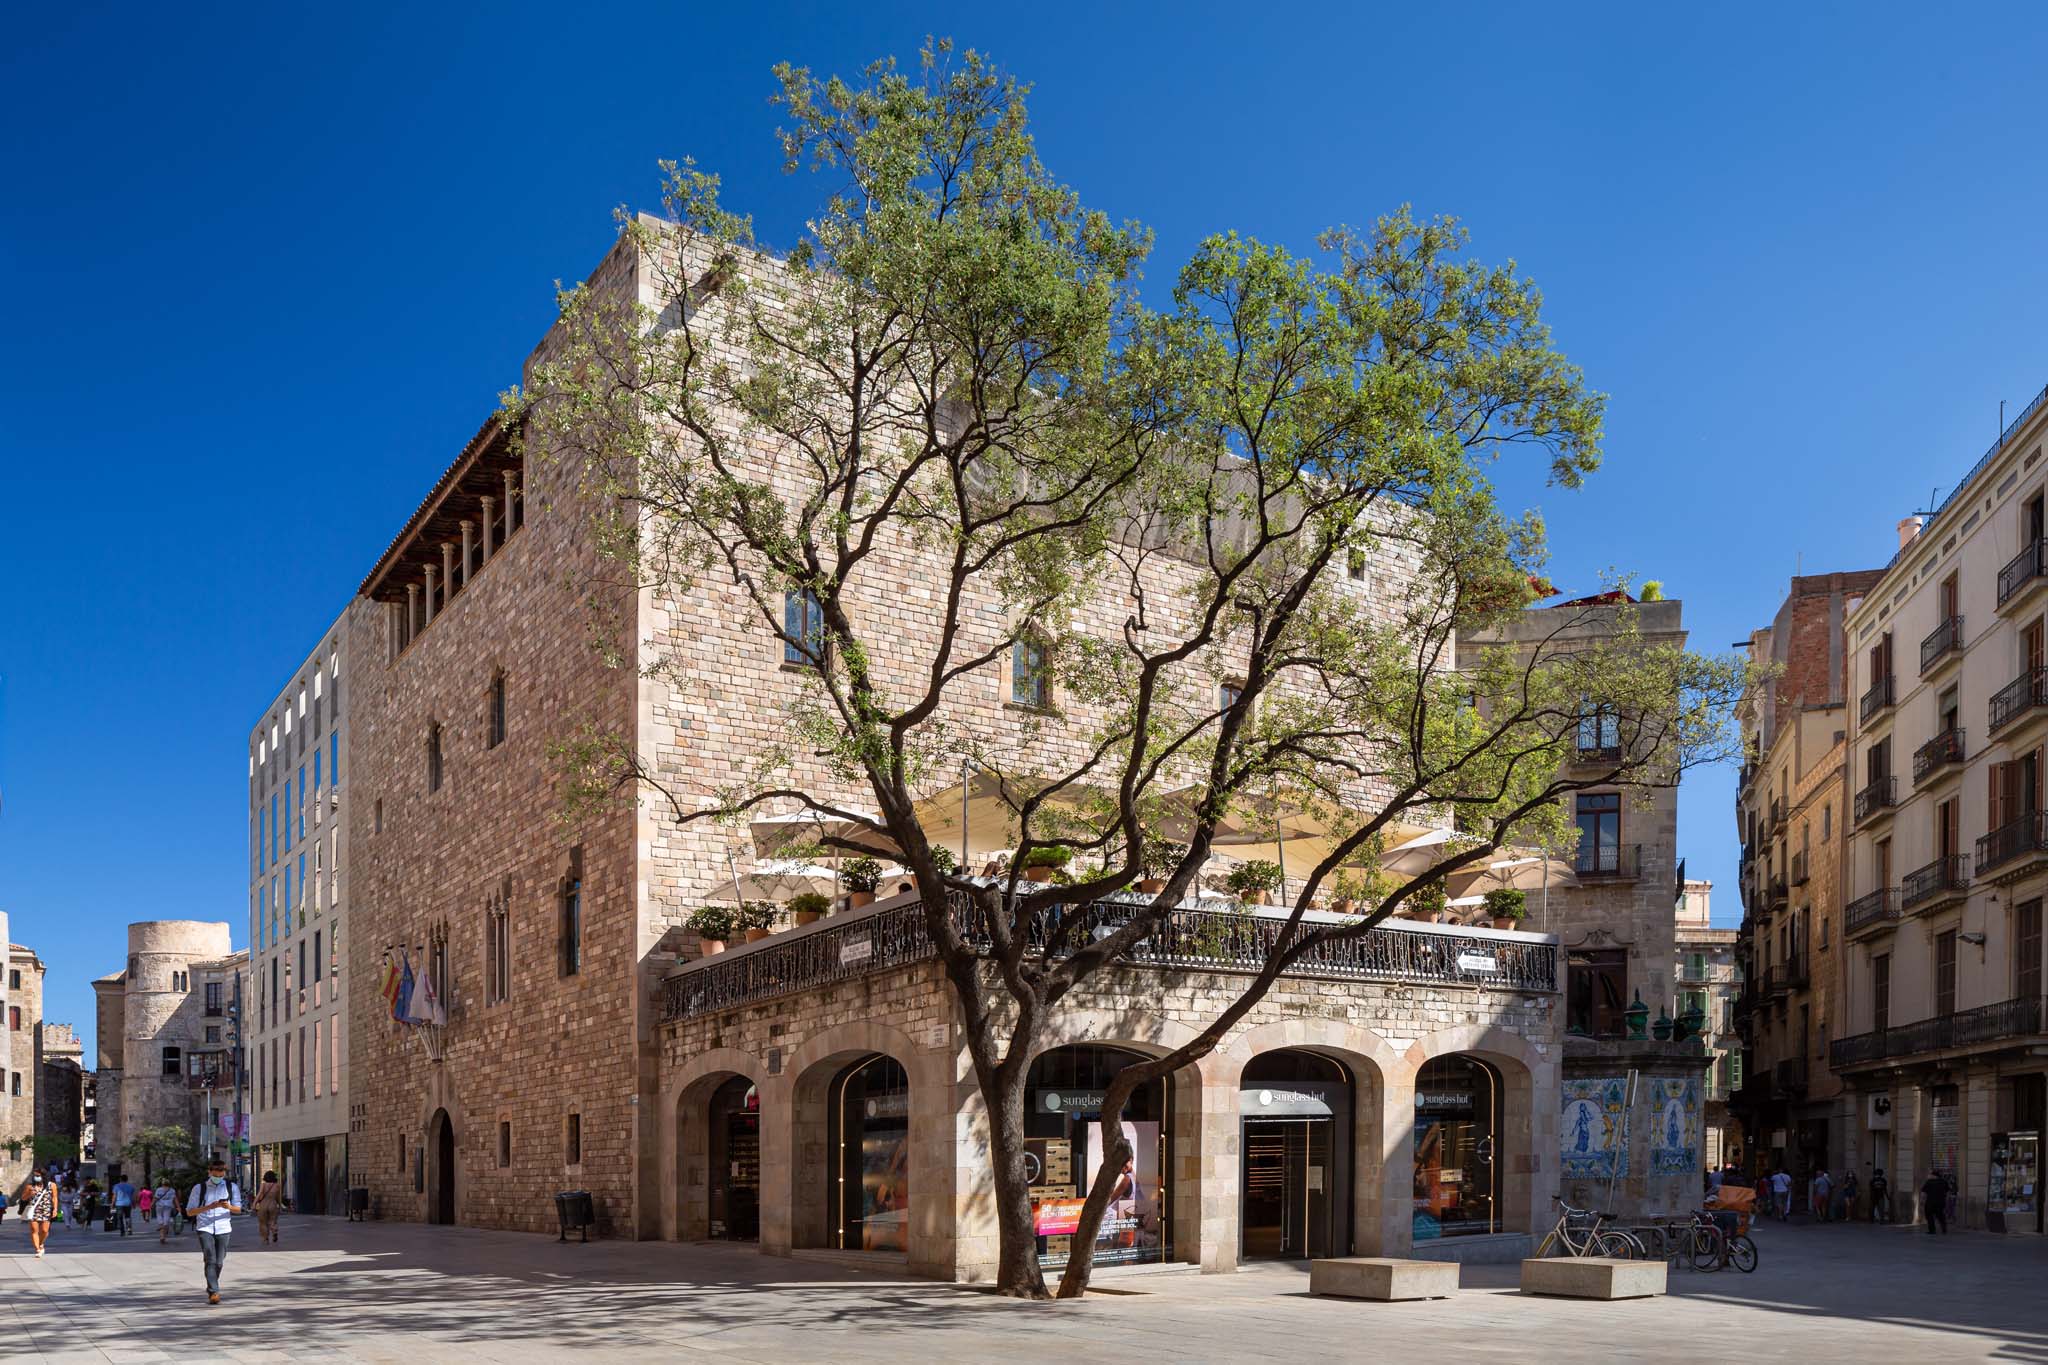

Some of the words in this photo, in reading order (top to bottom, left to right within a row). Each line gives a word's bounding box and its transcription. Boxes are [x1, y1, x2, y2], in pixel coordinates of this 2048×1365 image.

[1272, 1091, 1310, 1104] sunglass
[1311, 1090, 1325, 1102] hut
[1425, 1093, 1456, 1105] sunglass
